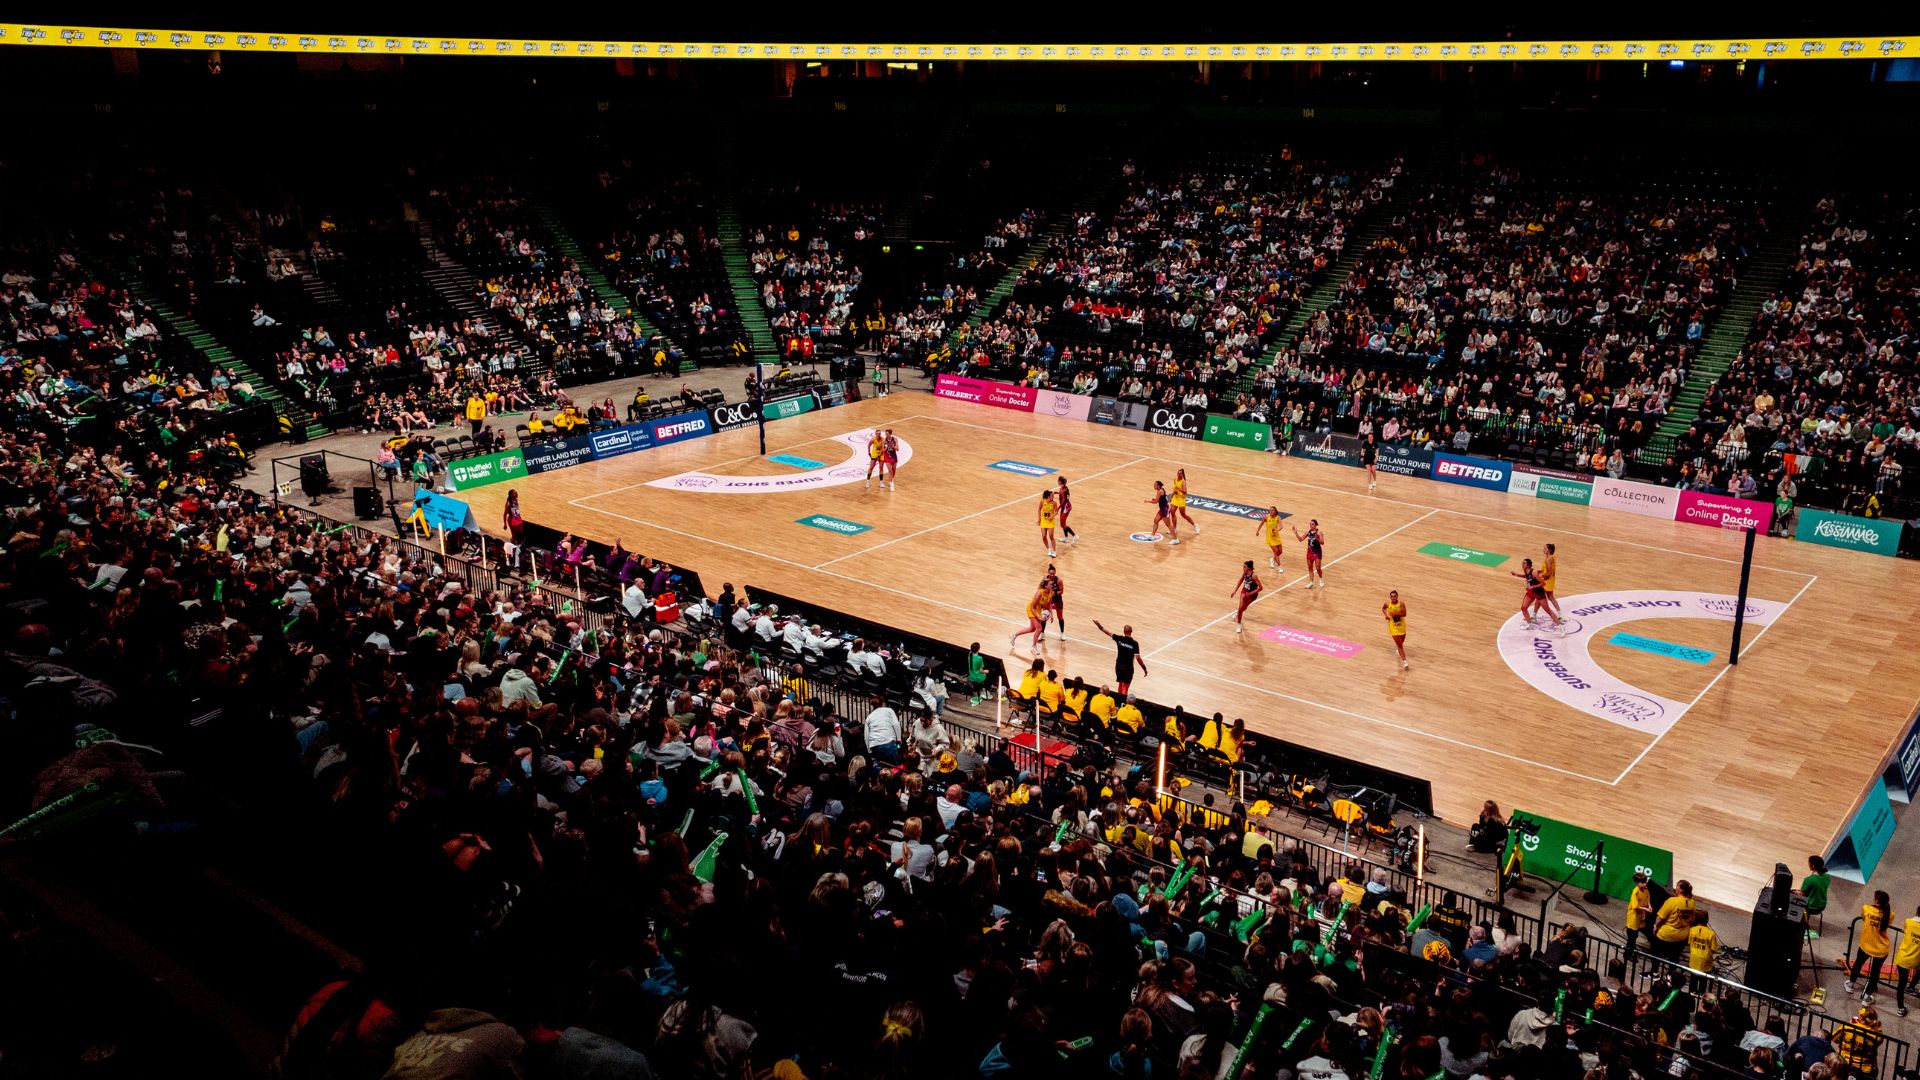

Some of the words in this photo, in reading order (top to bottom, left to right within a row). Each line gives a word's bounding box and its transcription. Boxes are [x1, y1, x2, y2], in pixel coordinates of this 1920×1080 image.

[945, 389, 974, 400] GILBERT
[988, 394, 1008, 403] Online
[1009, 397, 1030, 407] Doctor
[630, 429, 644, 437] global
[657, 419, 706, 438] BETFRED
[1150, 428, 1175, 436] INSURANCE
[1175, 431, 1196, 440] BROKERS
[597, 434, 628, 448] cardinal
[631, 434, 649, 442] logistics
[526, 456, 552, 466] SYTNER
[552, 451, 569, 460] LAND
[570, 447, 591, 457] ROVER
[1305, 444, 1347, 458] MANCHESTER
[467, 462, 492, 472] Nuffield
[543, 458, 579, 471] STOCKPORT
[1376, 463, 1415, 475] STOCKPORT
[1388, 457, 1407, 466] LAND
[1408, 460, 1431, 470] ROVER
[469, 470, 490, 480] Health
[1438, 461, 1503, 482] BETFRED
[1697, 499, 1742, 513] Superdrug
[1686, 507, 1719, 521] Online
[1722, 512, 1759, 527] Doctor
[1571, 602, 1626, 617] SUPER
[1632, 600, 1684, 608] SHOT
[1275, 629, 1314, 642] Doctor
[1317, 638, 1353, 651] Online
[1533, 638, 1553, 662] SHOT
[1543, 661, 1592, 691] SUPER
[1565, 844, 1593, 860] Shop
[1634, 865, 1653, 876] ao
